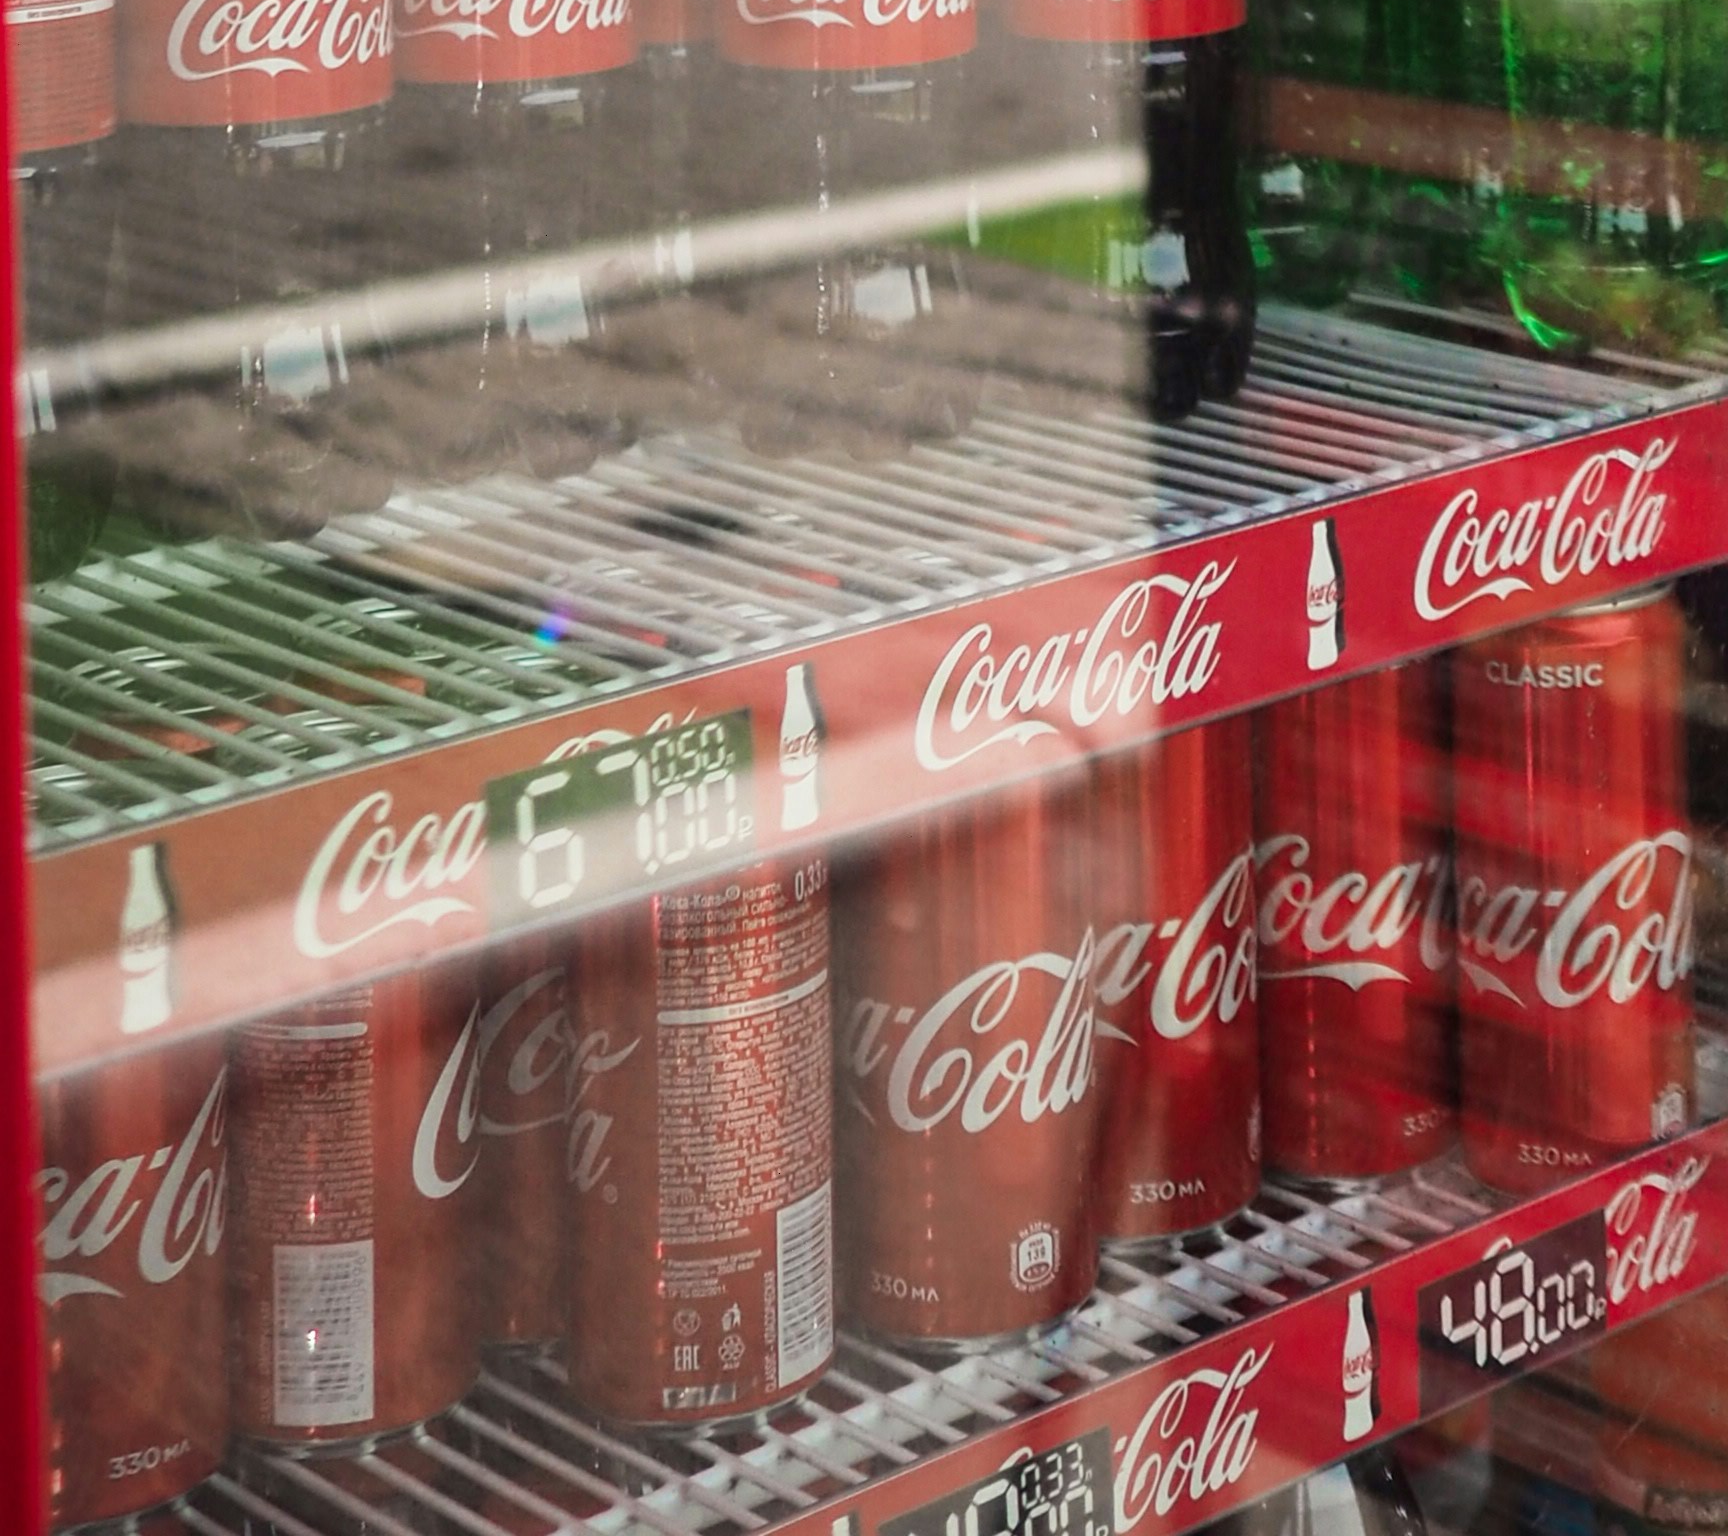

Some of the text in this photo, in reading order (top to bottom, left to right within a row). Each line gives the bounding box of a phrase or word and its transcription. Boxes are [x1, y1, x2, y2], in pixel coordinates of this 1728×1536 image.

[1413, 434, 1677, 623] Coca-Cola
[914, 556, 1237, 772] Coca-Cola
[1485, 661, 1605, 689] CLASSIC
